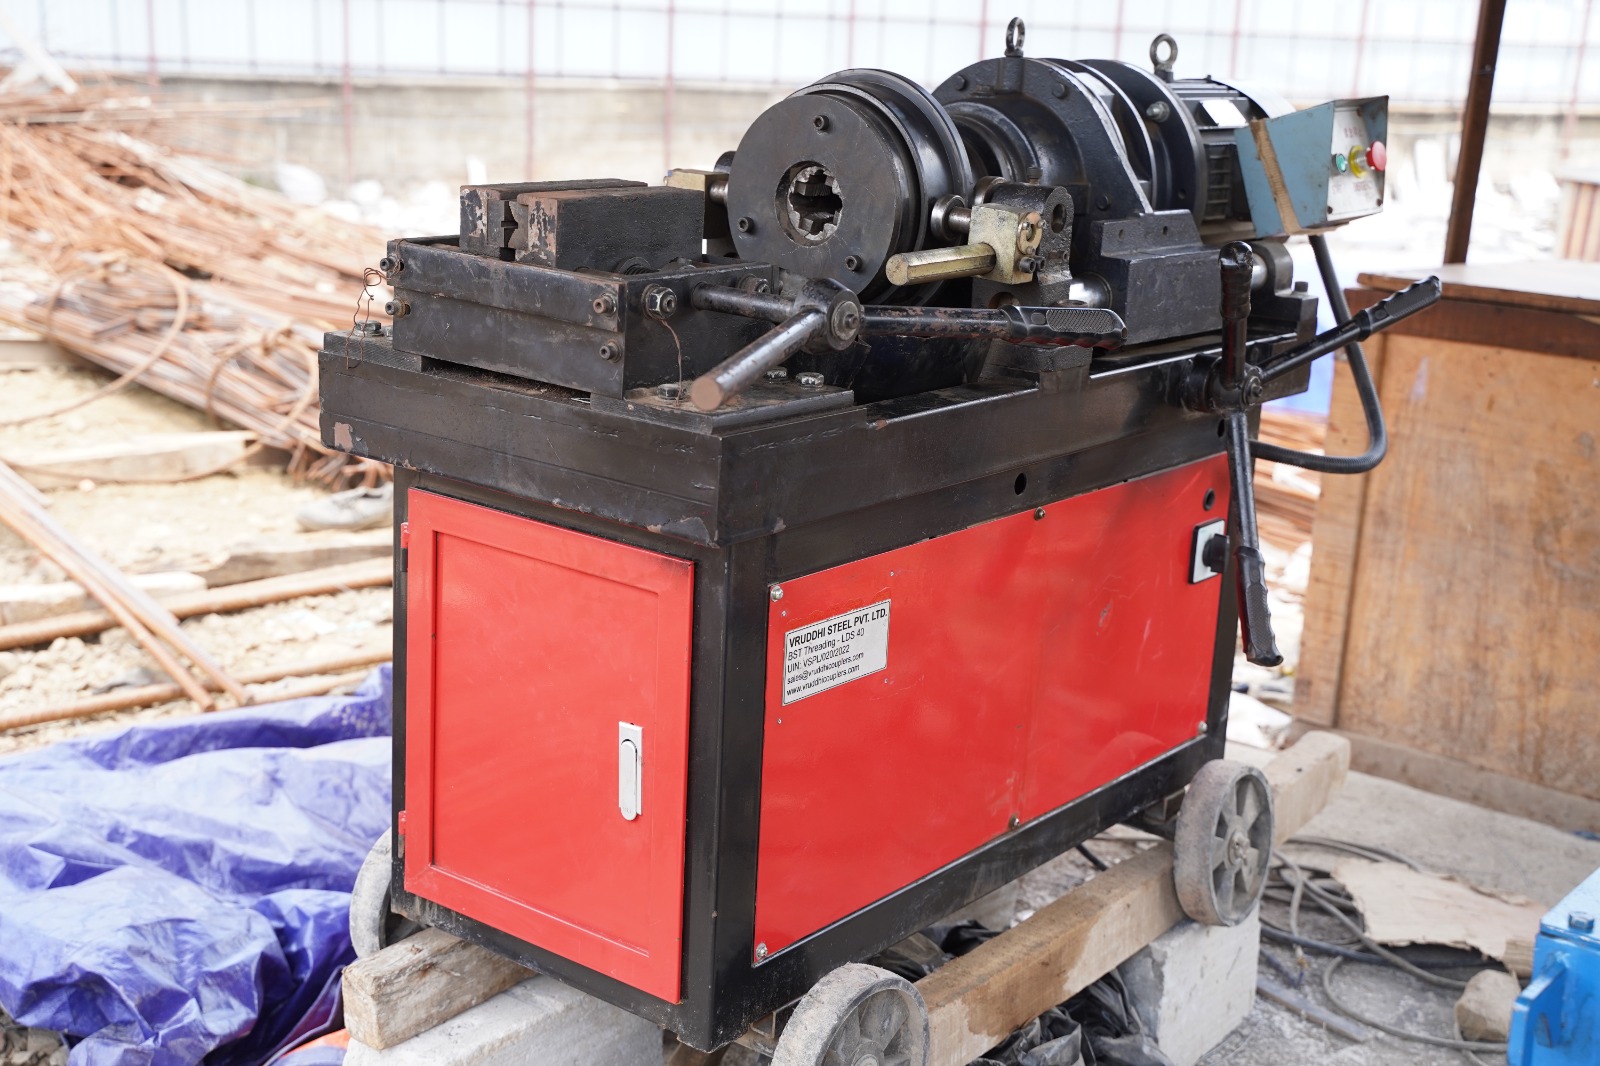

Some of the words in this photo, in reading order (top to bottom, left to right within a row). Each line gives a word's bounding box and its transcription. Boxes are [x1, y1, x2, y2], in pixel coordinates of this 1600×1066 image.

[788, 648, 802, 661] BST
[804, 638, 836, 656] Threading
[841, 630, 855, 643] LDS
[856, 627, 865, 637] 40
[789, 627, 826, 648] VRUDDHI
[827, 619, 852, 635] STEEL
[854, 613, 870, 627] PVT.
[872, 608, 887, 621] LTD.
[786, 664, 860, 696] www.vruddhicouplers.com
[787, 662, 801, 674] UIN:
[787, 651, 864, 685] sales@vruddhicouplers.com
